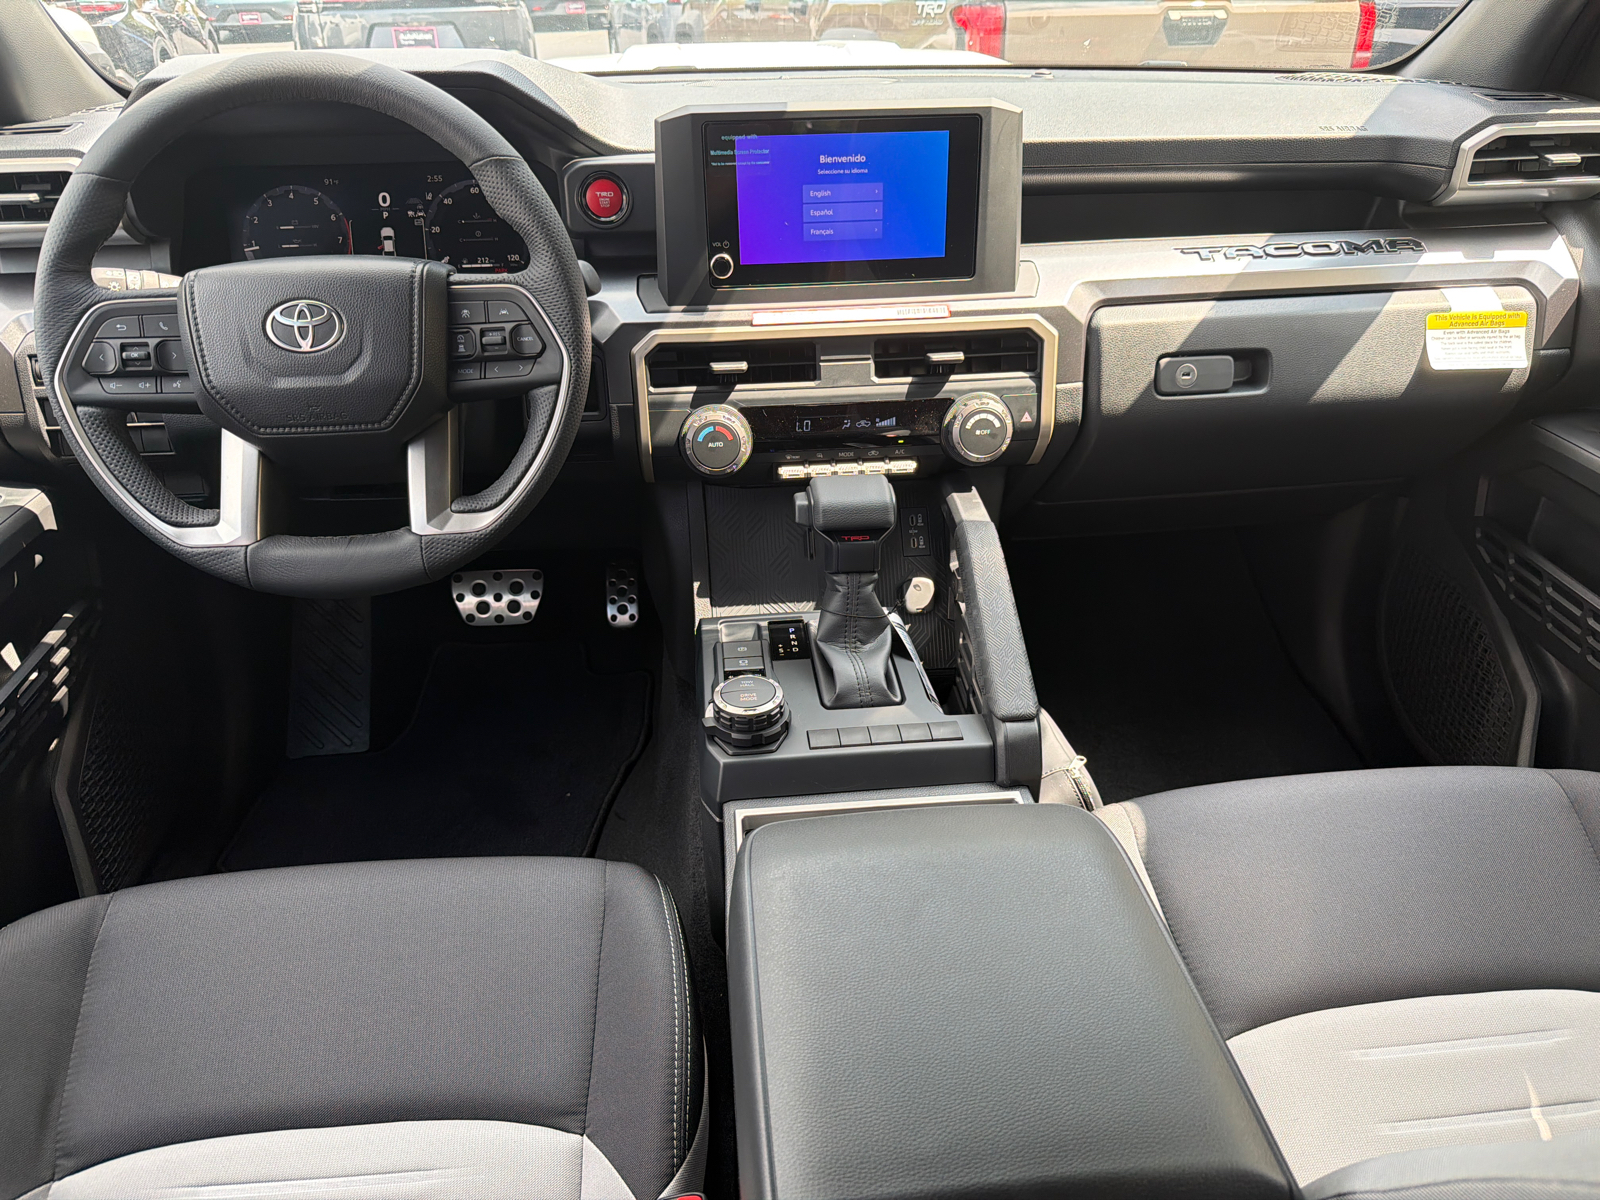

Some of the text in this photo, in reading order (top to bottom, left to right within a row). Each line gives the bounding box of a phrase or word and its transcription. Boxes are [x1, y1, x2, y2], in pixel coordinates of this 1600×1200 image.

[916, 0, 946, 18] TRD
[820, 154, 866, 163] Bienvenido
[378, 192, 390, 207] 0
[1172, 238, 1427, 262] TACOMA
